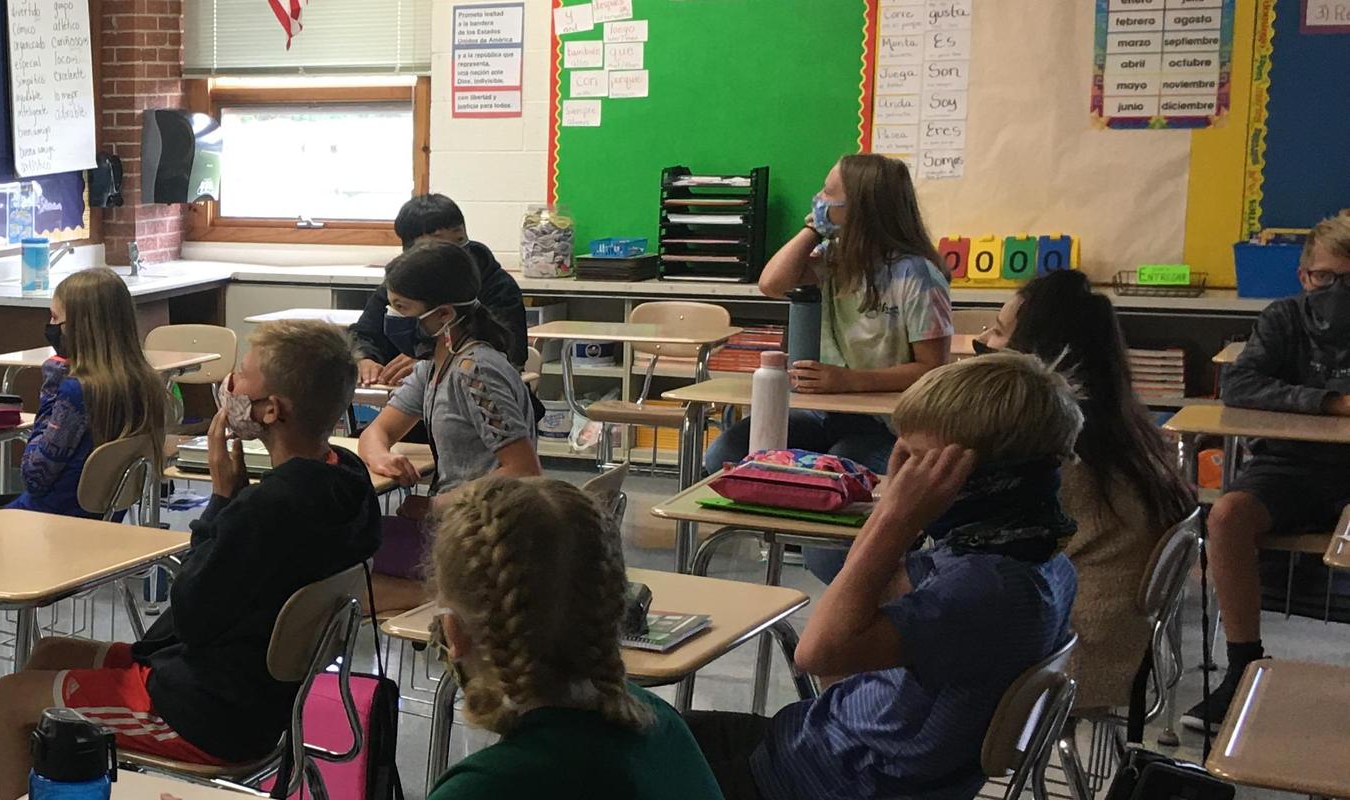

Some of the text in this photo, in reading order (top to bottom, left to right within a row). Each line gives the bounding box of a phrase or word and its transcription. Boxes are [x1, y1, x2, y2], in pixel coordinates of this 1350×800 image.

[928, 4, 970, 25] gusta
[1115, 17, 1156, 26] febrero
[1173, 15, 1212, 26] agosto
[933, 33, 956, 48] Es
[1117, 39, 1152, 48] marzo
[1164, 36, 1219, 47] septiembre
[610, 47, 635, 62] que
[1120, 59, 1146, 69] abril
[1168, 58, 1212, 68] octubre
[879, 68, 918, 81] Juega
[928, 63, 962, 79] Son
[576, 76, 598, 87] con
[1116, 81, 1147, 91] mayo
[1162, 80, 1216, 89] noviembre
[930, 93, 958, 112] Soy
[1118, 102, 1144, 112] junio
[1161, 100, 1215, 111] diciembre
[925, 122, 961, 137] Eres
[923, 151, 964, 169] Somos
[975, 251, 995, 273] 0
[1009, 251, 1029, 273] 0
[1044, 250, 1063, 270] 0
